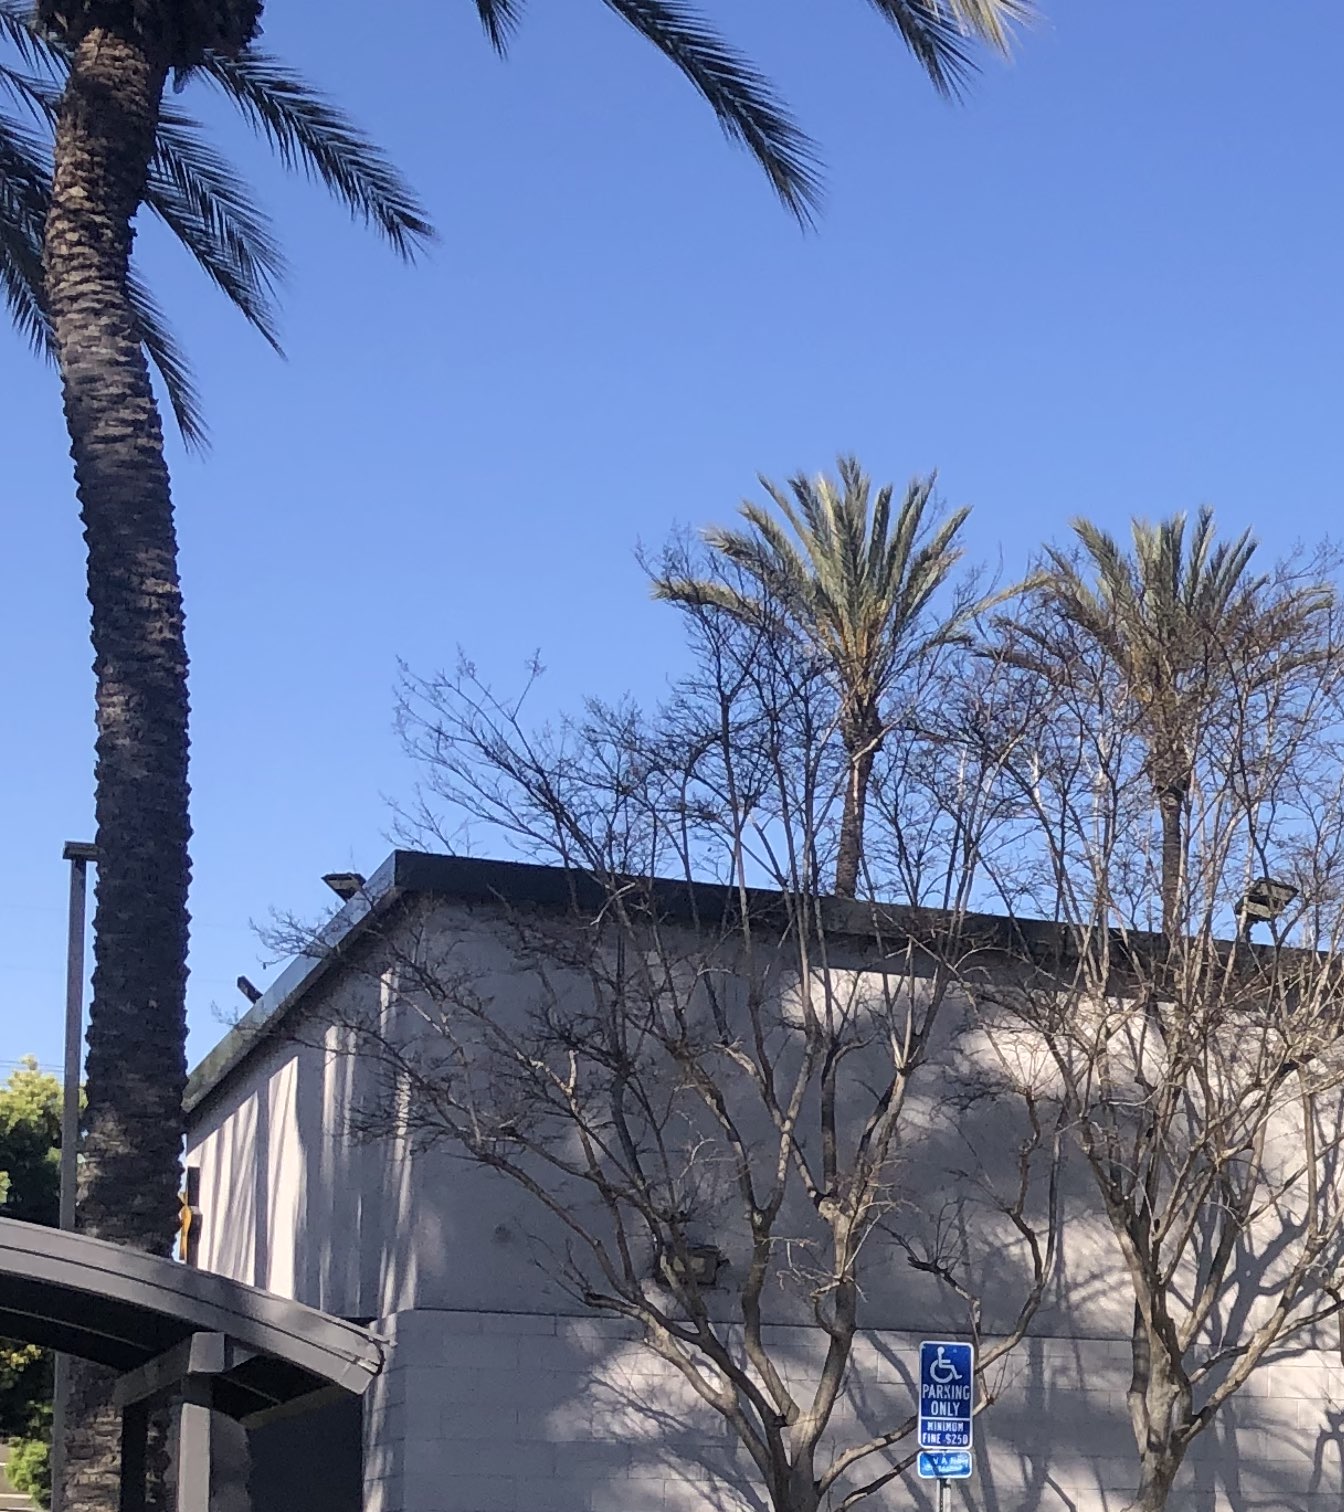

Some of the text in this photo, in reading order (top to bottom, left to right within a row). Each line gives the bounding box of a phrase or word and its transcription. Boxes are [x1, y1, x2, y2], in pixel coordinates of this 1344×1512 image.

[922, 1384, 971, 1400] PARKING
[930, 1401, 961, 1417] ONLY
[926, 1421, 964, 1432] MINIMUM
[922, 1433, 969, 1445] FINE $250
